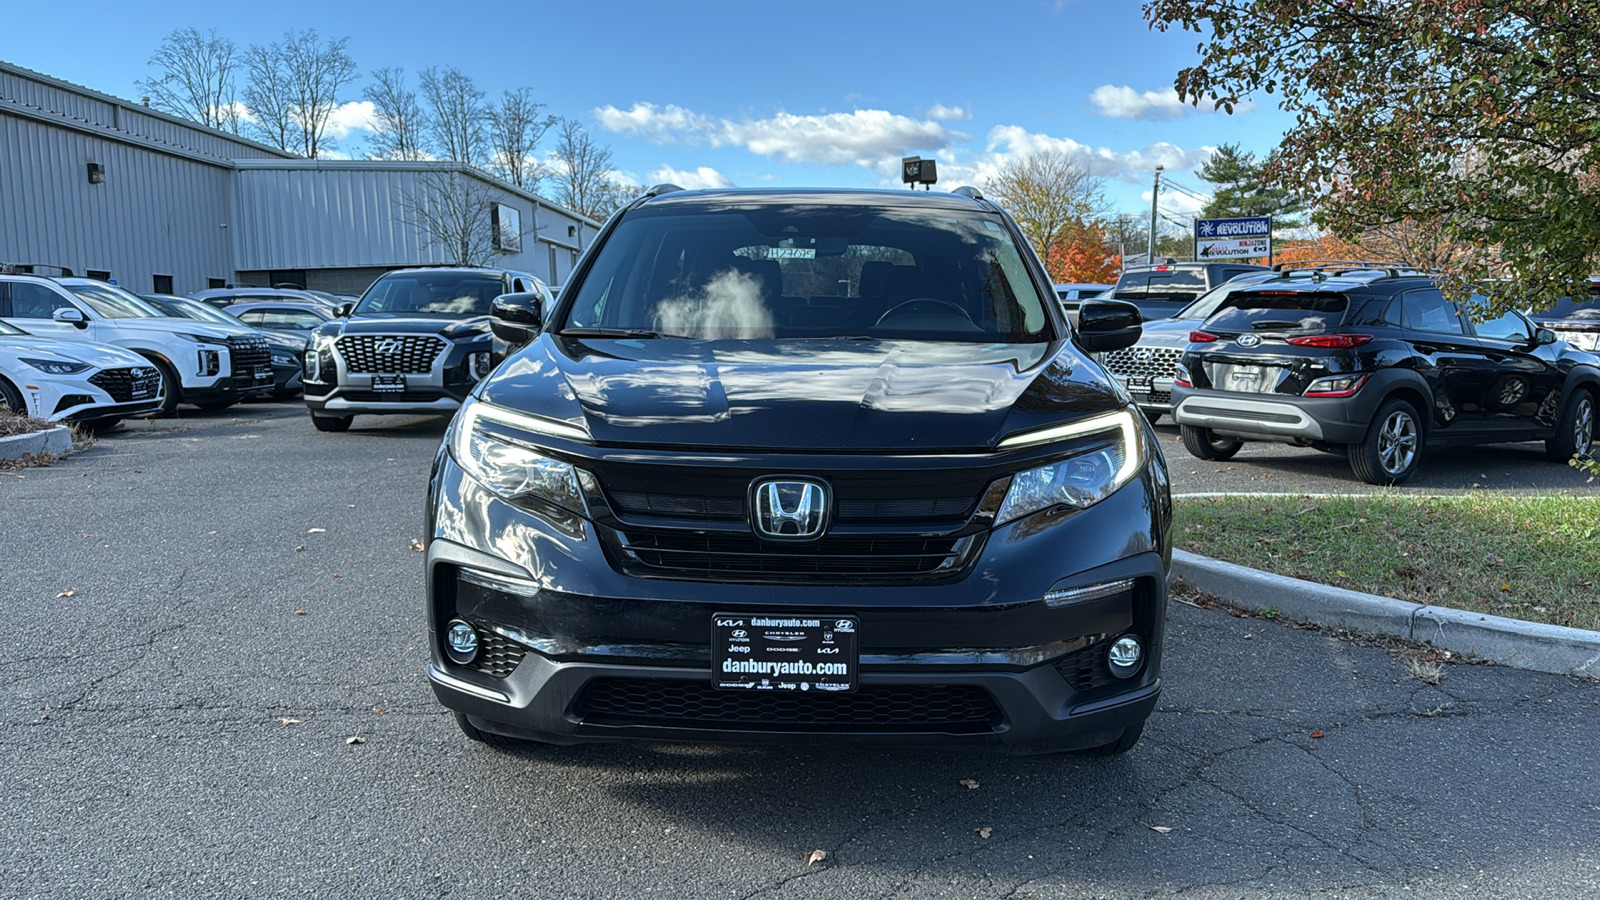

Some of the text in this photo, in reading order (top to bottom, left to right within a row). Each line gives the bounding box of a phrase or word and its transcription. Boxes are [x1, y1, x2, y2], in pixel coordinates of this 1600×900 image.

[1217, 223, 1268, 235] REVOLUTION
[751, 617, 820, 628] danburyauto.com
[728, 645, 751, 654] Jeep
[722, 658, 847, 677] danburyauto.com
[777, 681, 797, 690] Jeep
